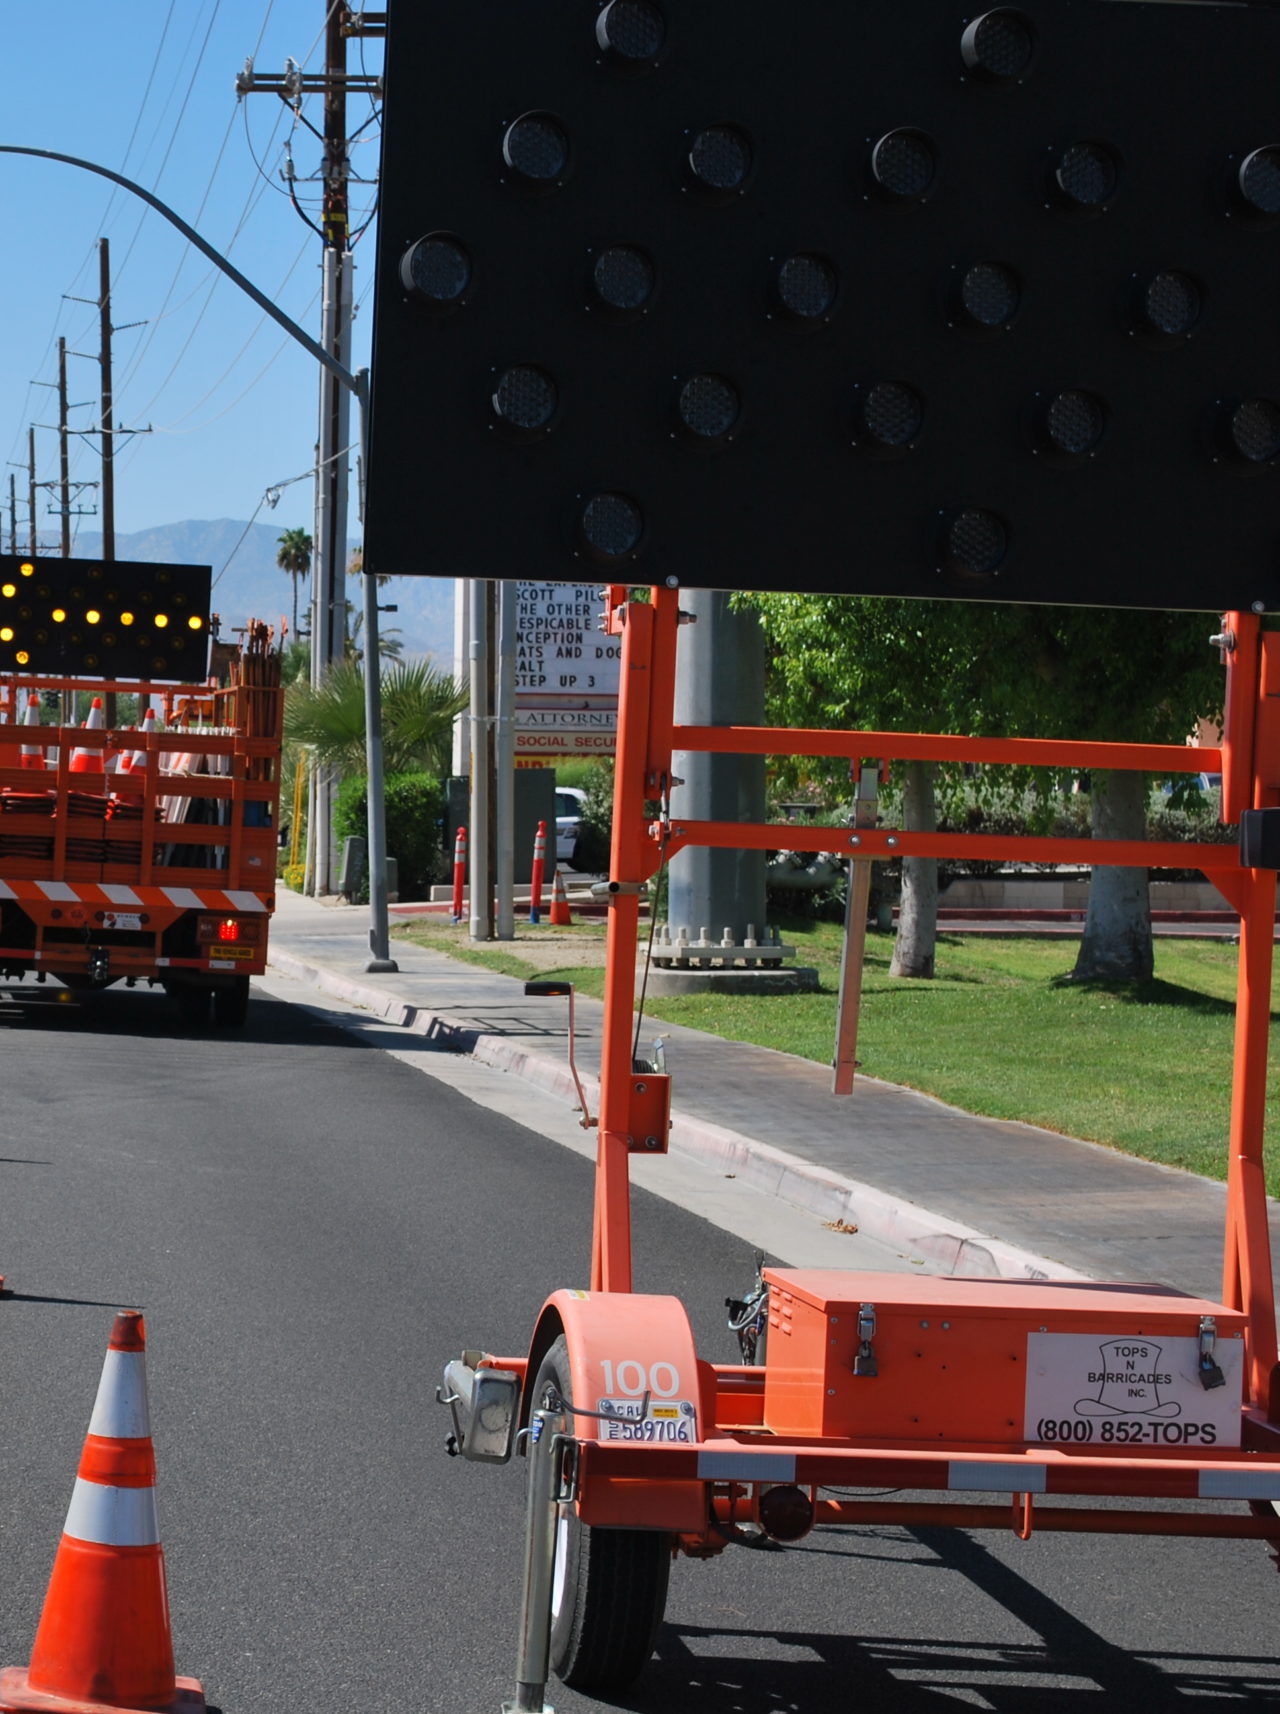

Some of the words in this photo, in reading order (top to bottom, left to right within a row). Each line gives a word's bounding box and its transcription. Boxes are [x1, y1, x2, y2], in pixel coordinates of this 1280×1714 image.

[516, 602, 537, 615] HE
[546, 603, 591, 616] OTHER
[517, 617, 591, 630] ESPICABLE
[516, 632, 583, 644] NCEPTION
[518, 646, 543, 658] ATS
[556, 646, 582, 659] AND
[515, 660, 545, 672] ALT
[515, 674, 547, 687] STEP
[559, 675, 577, 688] UP
[587, 675, 596, 688] 3
[526, 713, 618, 724] ATTORNE
[516, 735, 568, 747] SOCIAL
[574, 736, 617, 748] SECU
[1113, 1346, 1149, 1358] TOPS
[1125, 1360, 1135, 1371] N
[600, 1359, 680, 1398] 100
[1087, 1372, 1173, 1385] BARRICADES
[1127, 1388, 1147, 1398] INC.
[1036, 1418, 1093, 1442] (800)
[1100, 1420, 1217, 1445] 852-TOPS
